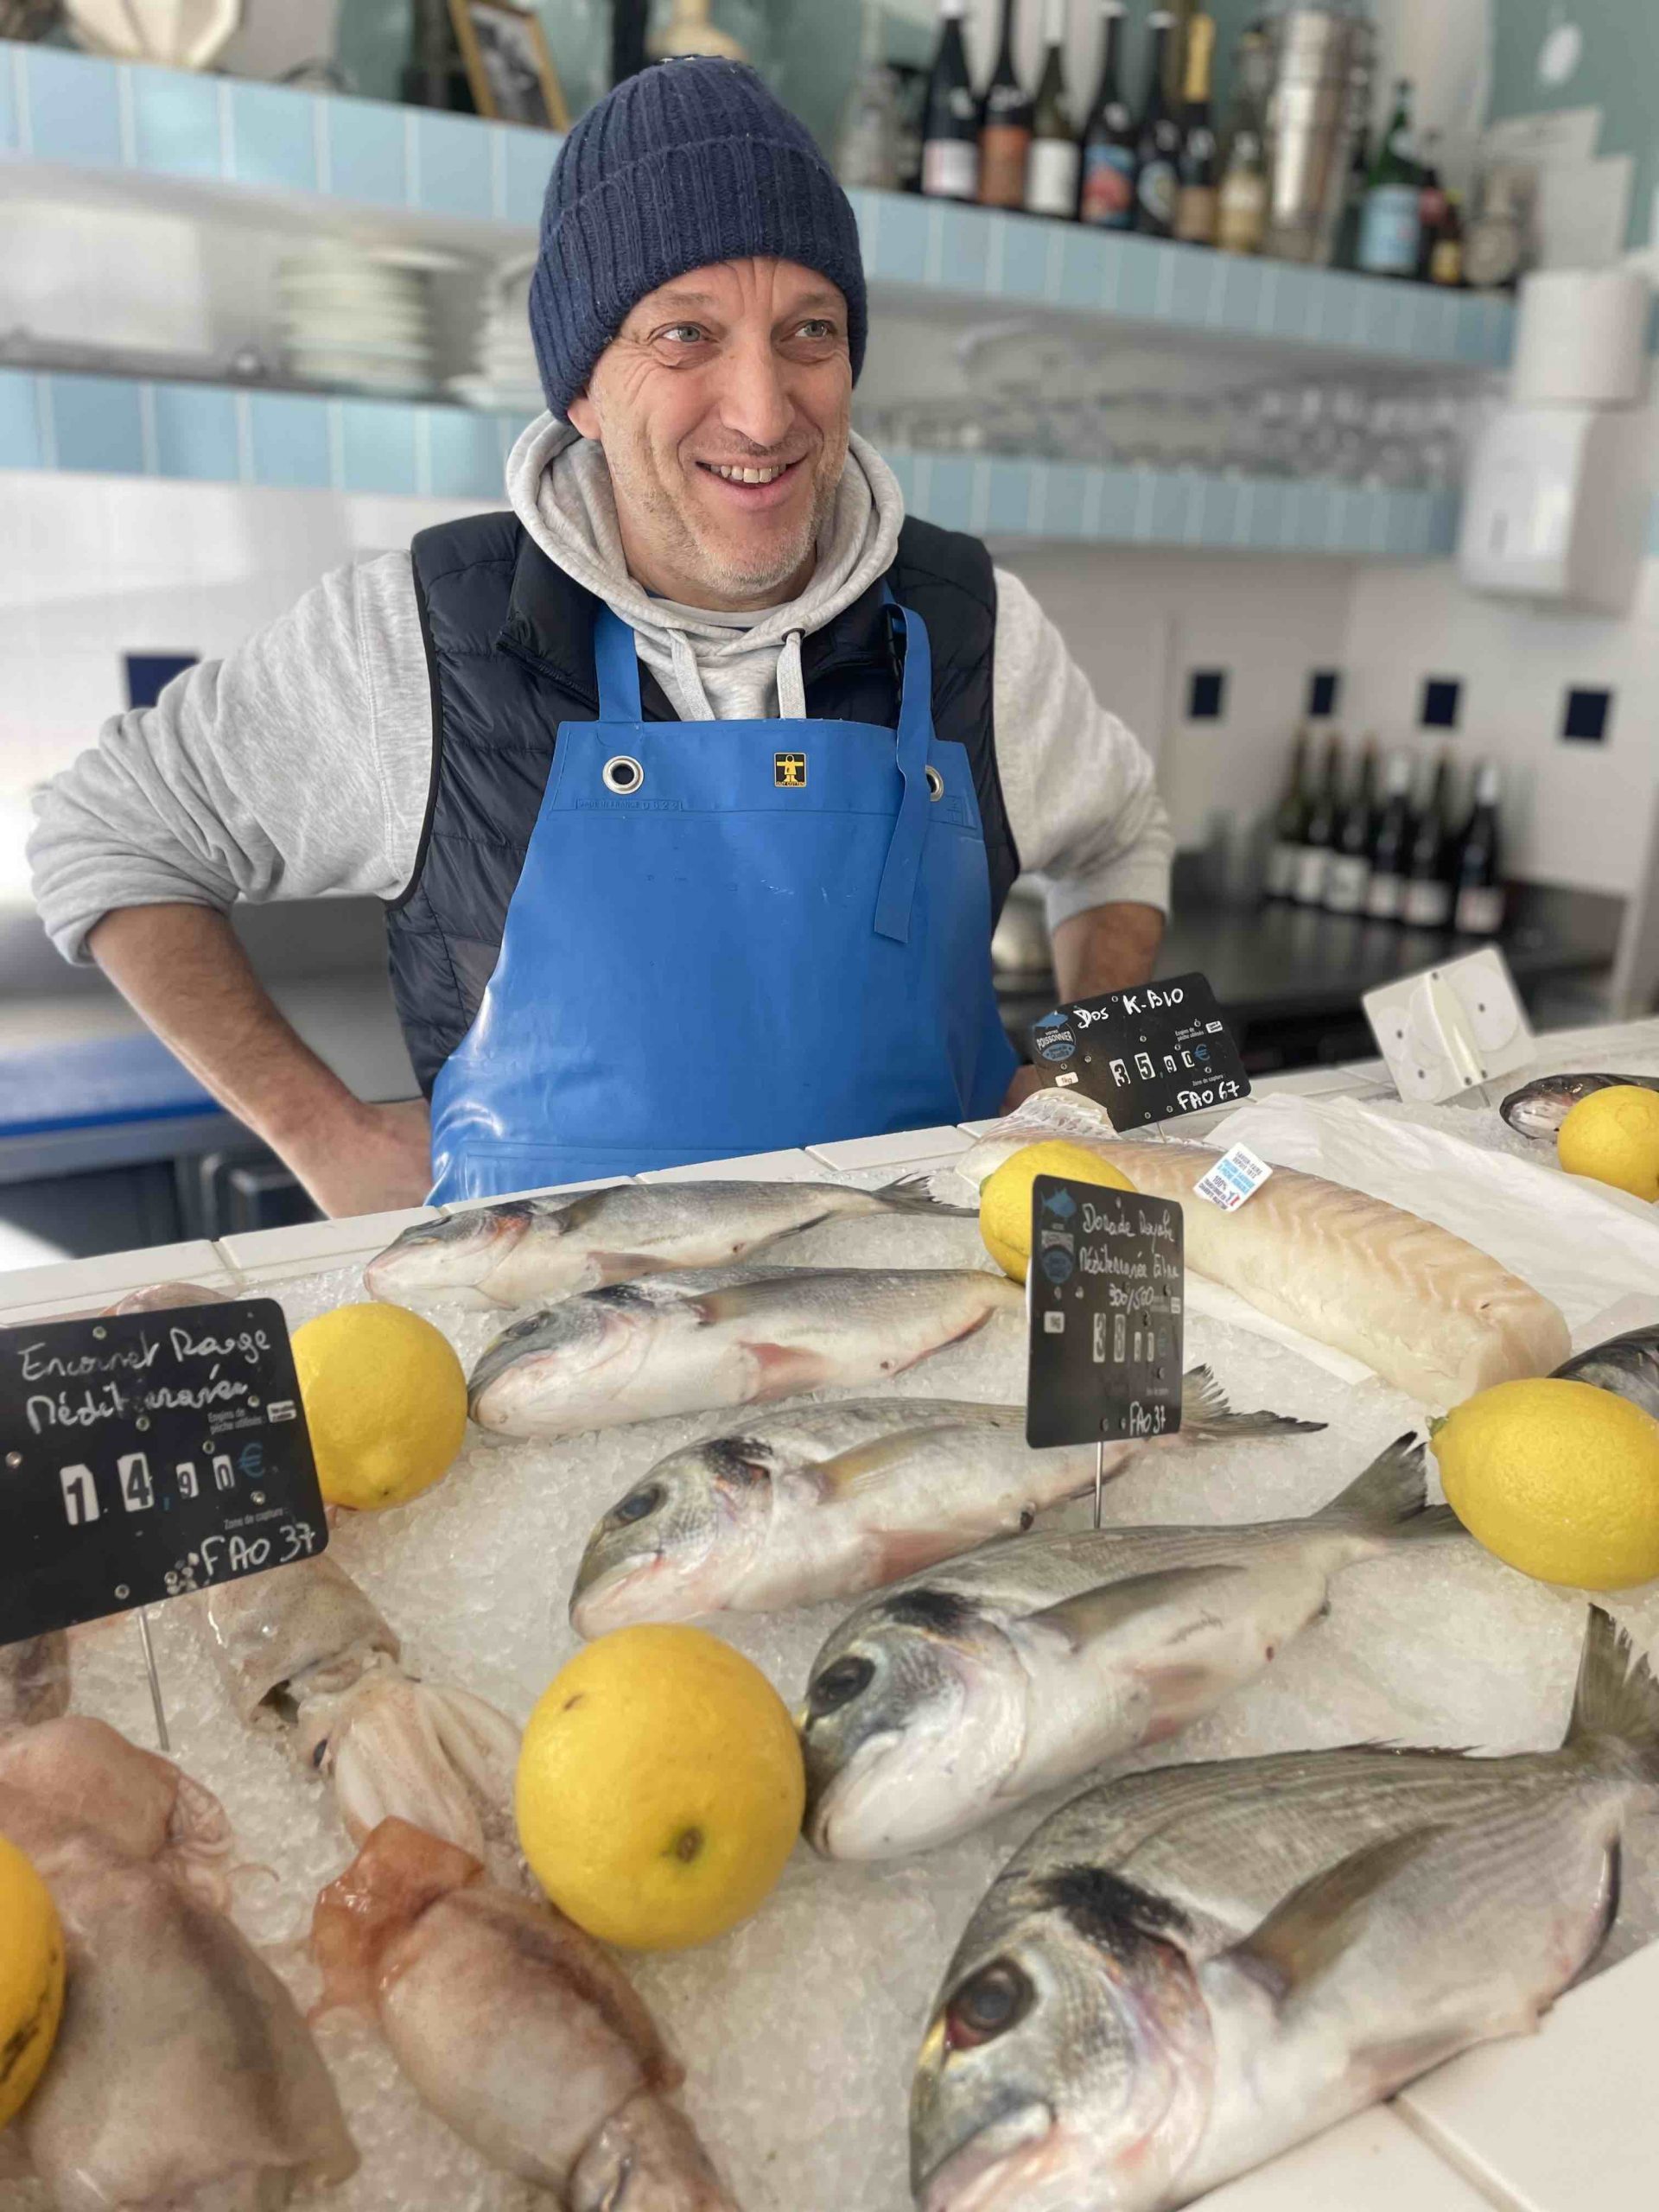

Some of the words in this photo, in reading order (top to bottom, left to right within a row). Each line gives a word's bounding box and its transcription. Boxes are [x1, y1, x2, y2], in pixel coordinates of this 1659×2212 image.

[1073, 1007, 1109, 1028] Dos
[1037, 1031, 1073, 1051] POISSONNIER
[1177, 1090, 1213, 1110] FAO
[1082, 1203, 1136, 1236] Dorade
[17, 1330, 159, 1381] Encornet
[169, 1328, 270, 1363] Rouge
[1130, 1401, 1152, 1436] FAO
[1153, 1405, 1166, 1433] 37
[200, 1535, 270, 1576] FAO
[280, 1522, 315, 1562] 37
